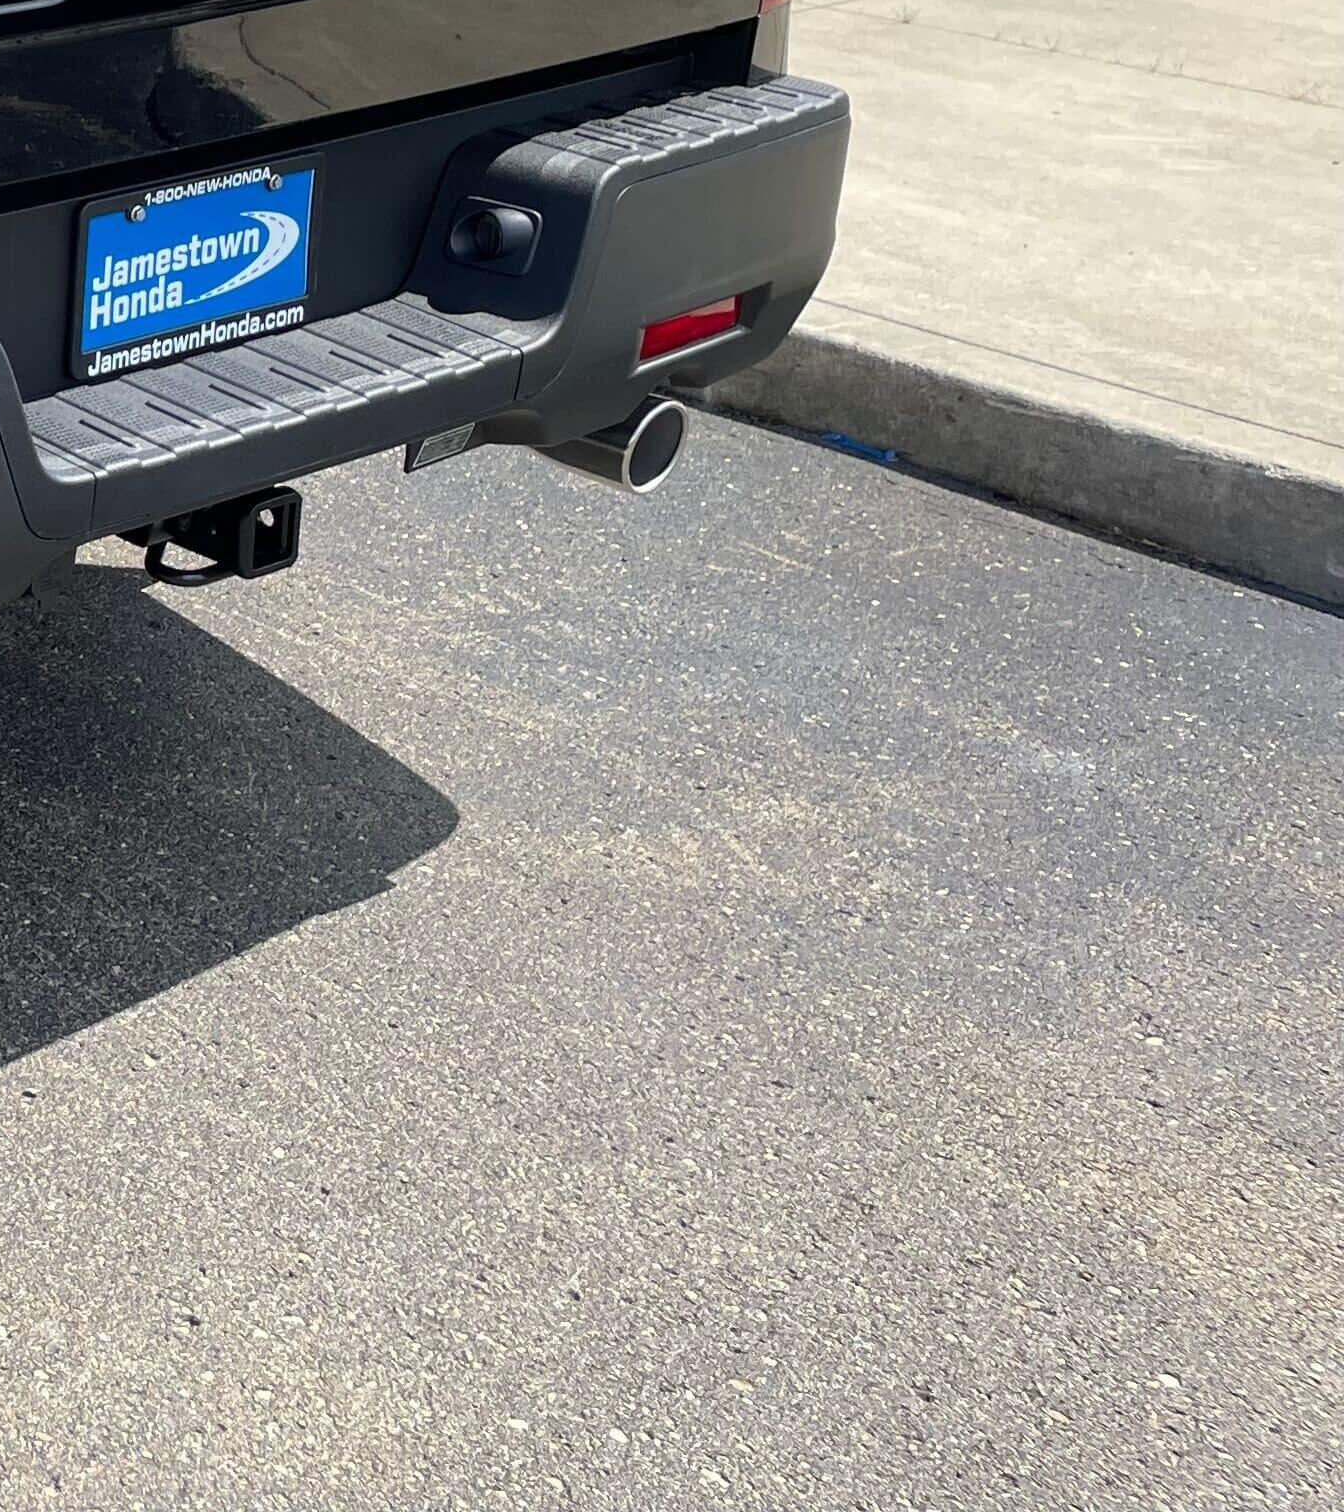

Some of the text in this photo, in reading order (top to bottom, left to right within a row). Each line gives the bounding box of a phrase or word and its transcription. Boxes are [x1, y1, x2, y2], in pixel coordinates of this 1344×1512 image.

[143, 166, 272, 207] 1-800-NEW-HONDA
[92, 226, 261, 292] Jamestown
[89, 275, 184, 330] Honda
[87, 304, 305, 377] JamestownHonda.com
